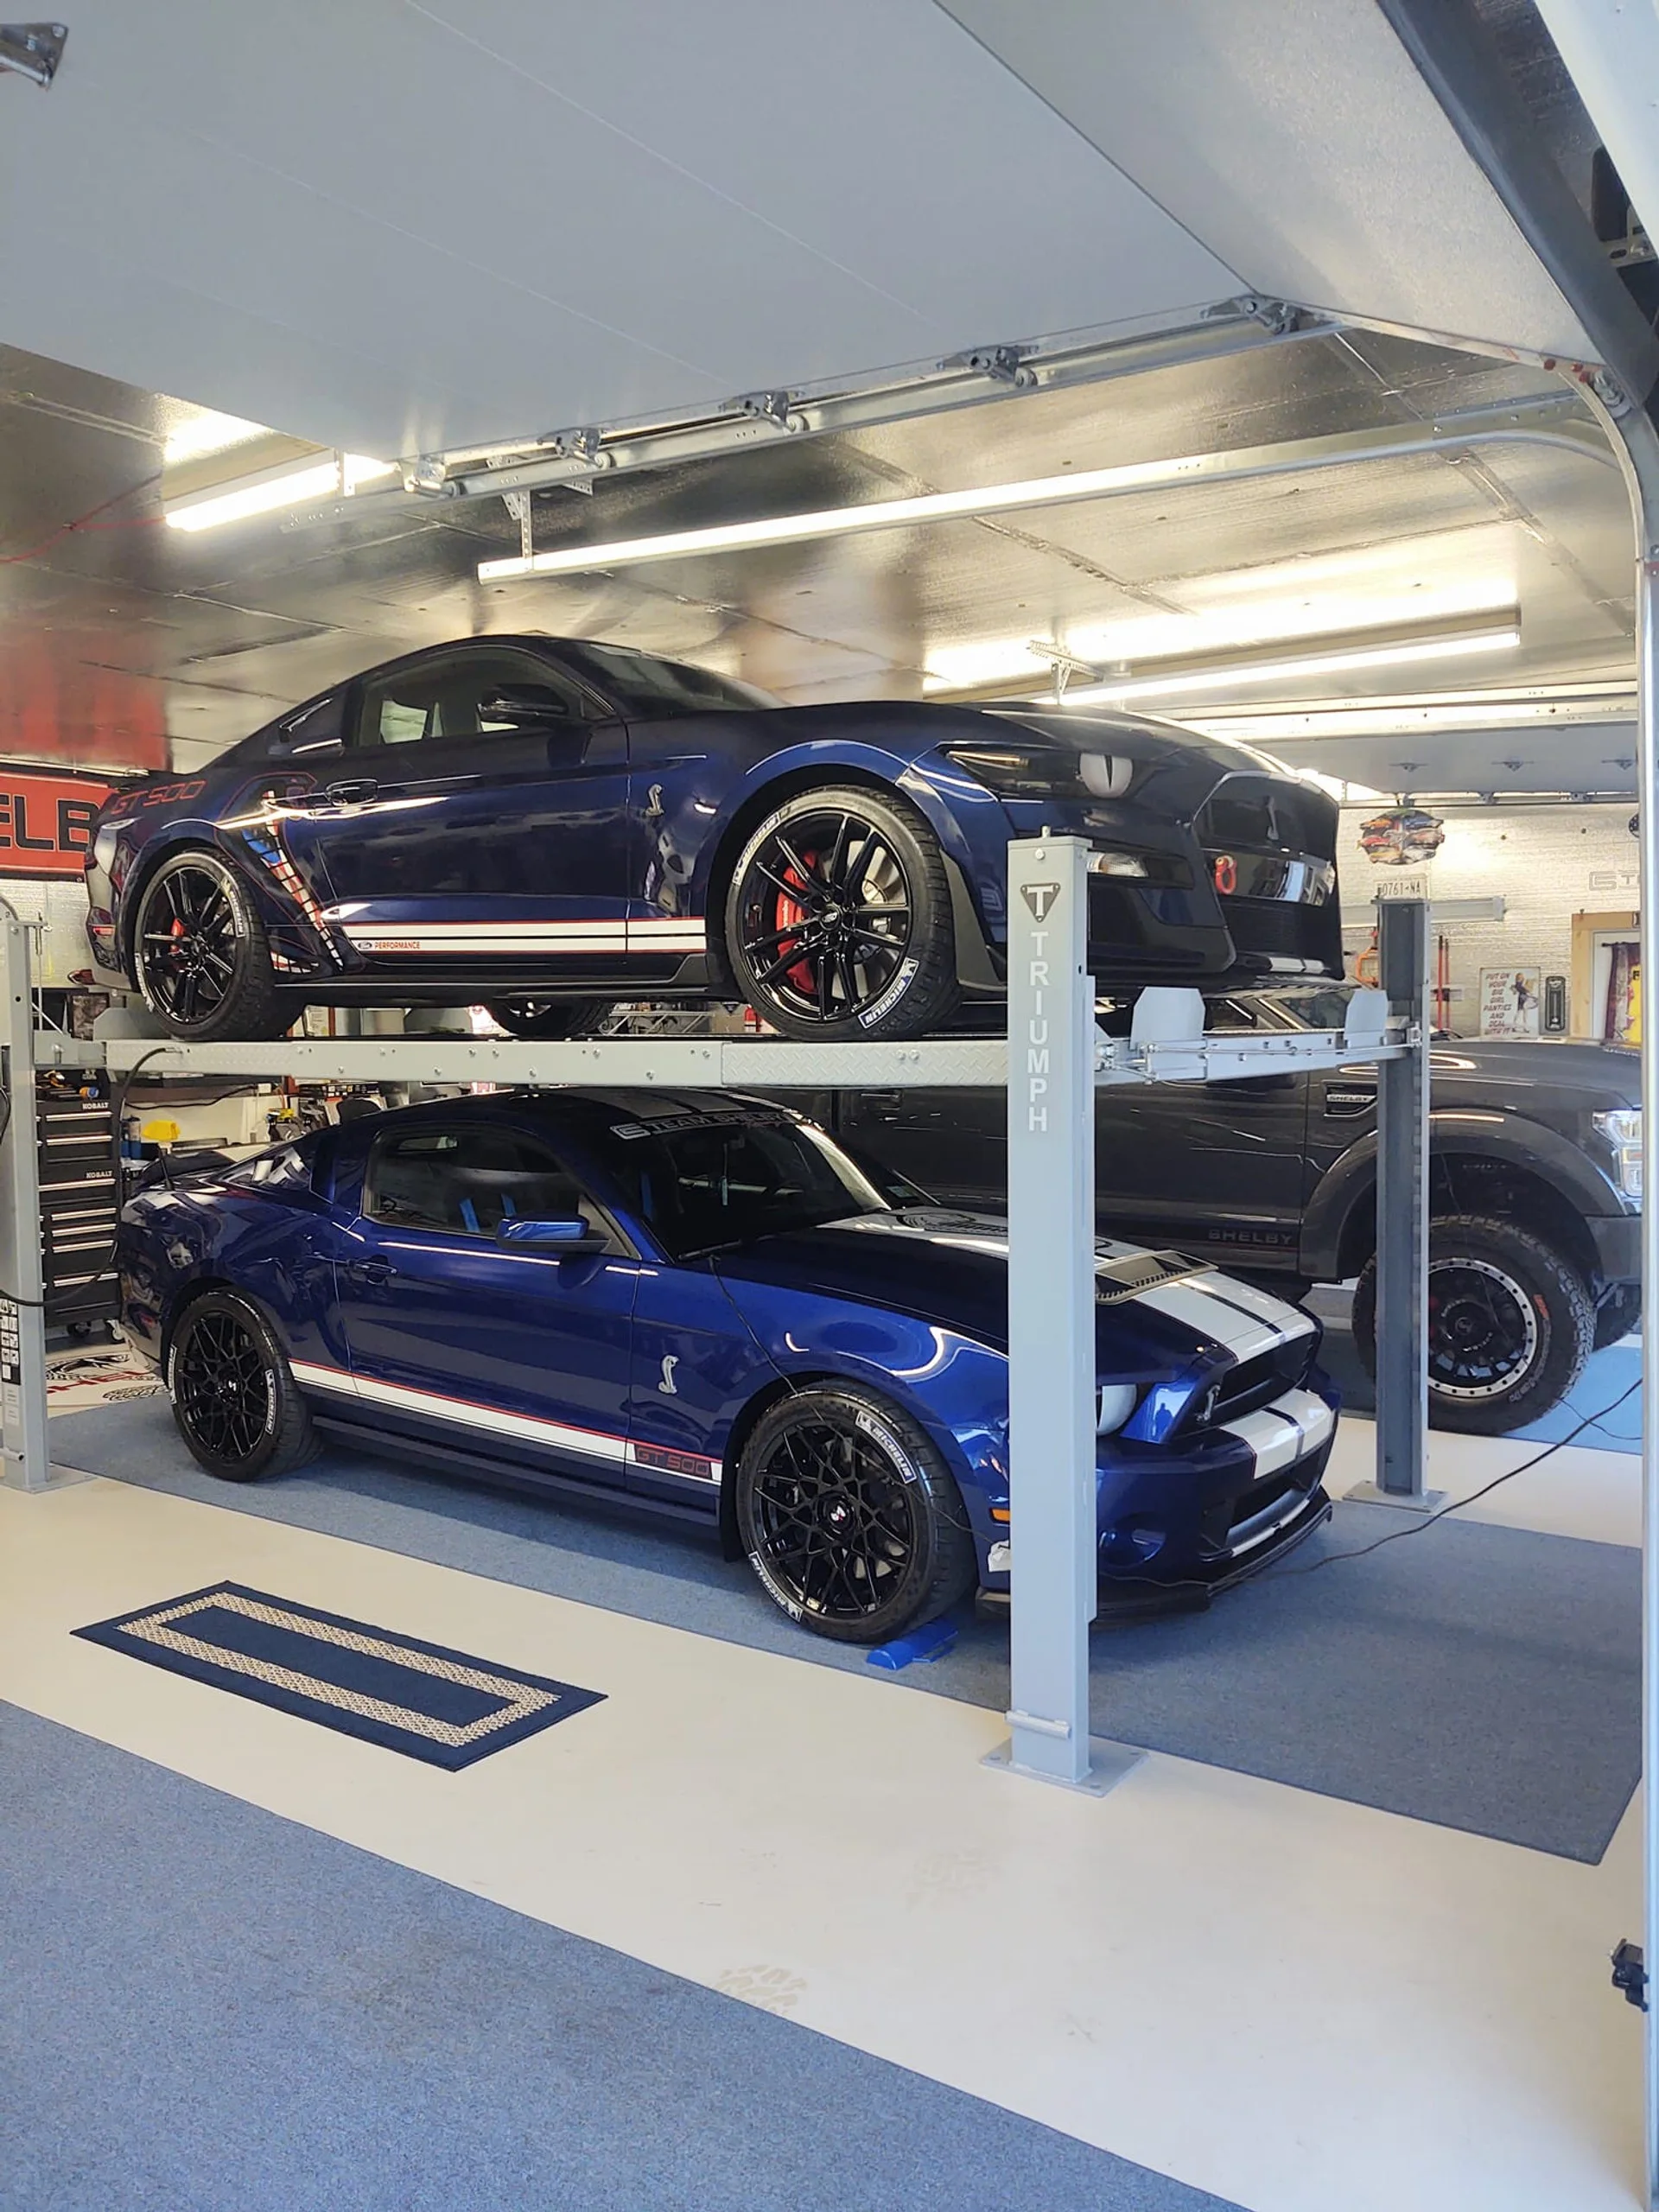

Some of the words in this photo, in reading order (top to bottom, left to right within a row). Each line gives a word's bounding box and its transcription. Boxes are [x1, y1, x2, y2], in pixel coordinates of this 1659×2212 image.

[374, 941, 421, 950] PERFORMANCE
[865, 978, 907, 1025] MICHELIN
[1027, 931, 1052, 1132] TRIUMPH
[82, 1102, 109, 1110] KOBALT
[86, 1170, 113, 1179] KOBALT
[1208, 1229, 1292, 1244] SHELBY
[872, 1426, 912, 1477] MICHELIN
